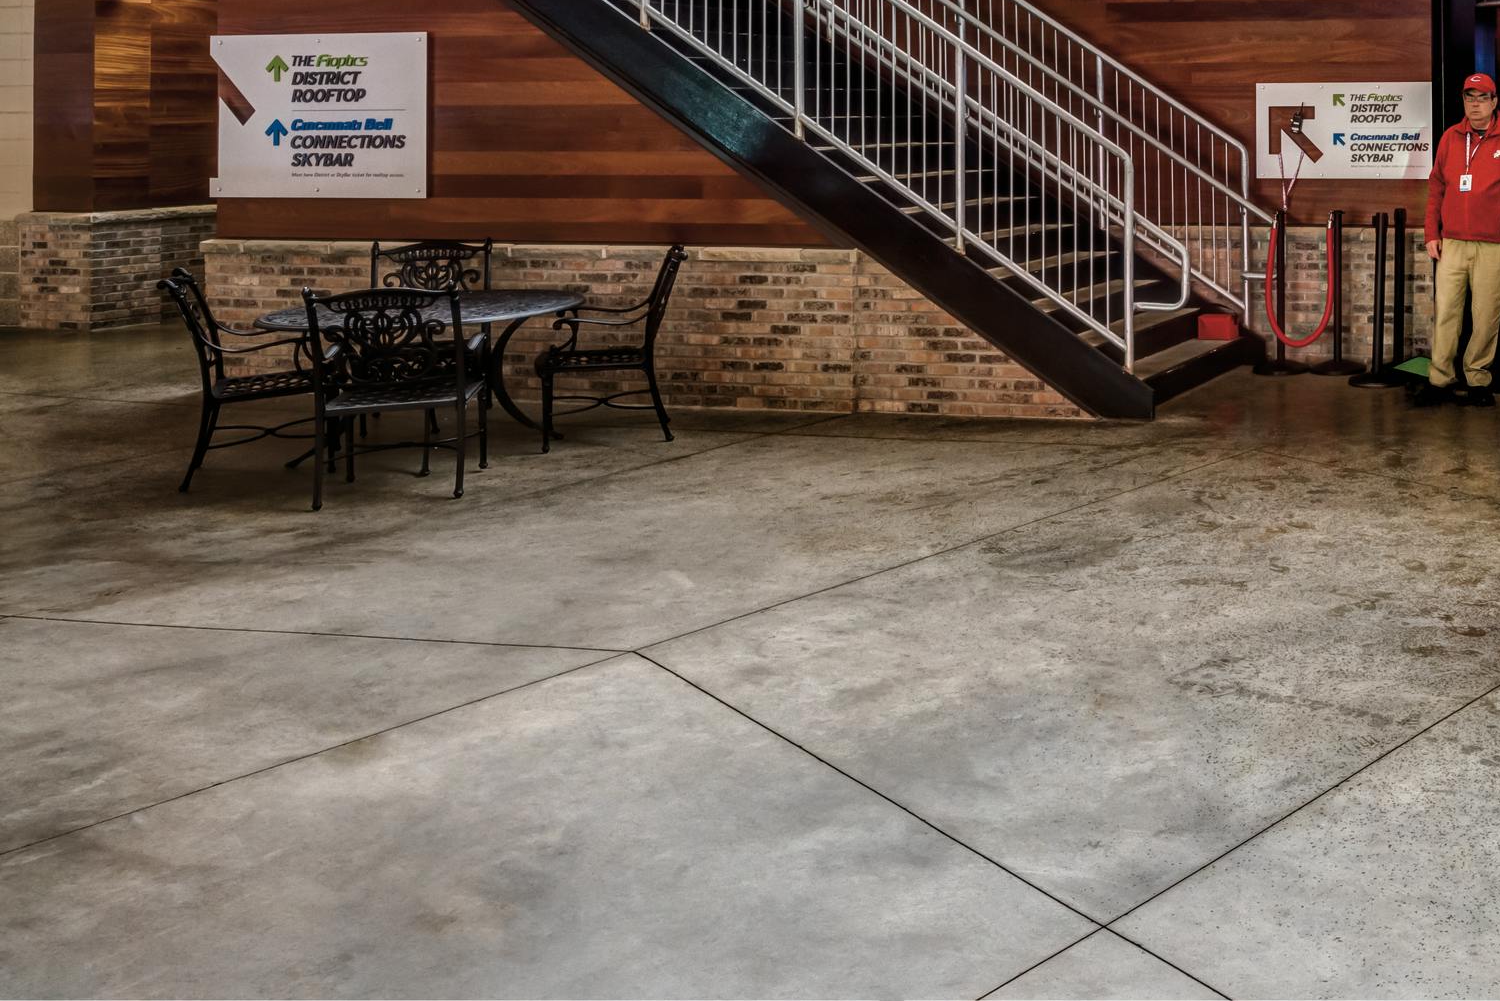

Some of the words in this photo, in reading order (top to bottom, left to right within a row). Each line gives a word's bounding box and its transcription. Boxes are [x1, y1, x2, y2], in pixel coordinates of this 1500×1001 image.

[291, 55, 316, 67] THE
[316, 54, 368, 69] Fioptics
[291, 71, 362, 85] DISTRICT
[291, 88, 366, 103] ROOFTOP
[1367, 93, 1403, 103] Fioptics
[1350, 104, 1398, 113] DISTRICT
[1350, 114, 1402, 123] ROOFTOP
[290, 118, 362, 131] Cincinnati
[364, 118, 393, 130] Bell
[290, 135, 406, 149] CONNECTIONS
[1350, 133, 1399, 141] Cincinnati
[1401, 133, 1420, 141] Bell
[1350, 143, 1429, 152] CONNECTIONS
[291, 153, 355, 167] SKYBAR
[1350, 154, 1393, 163] SKYBAR
